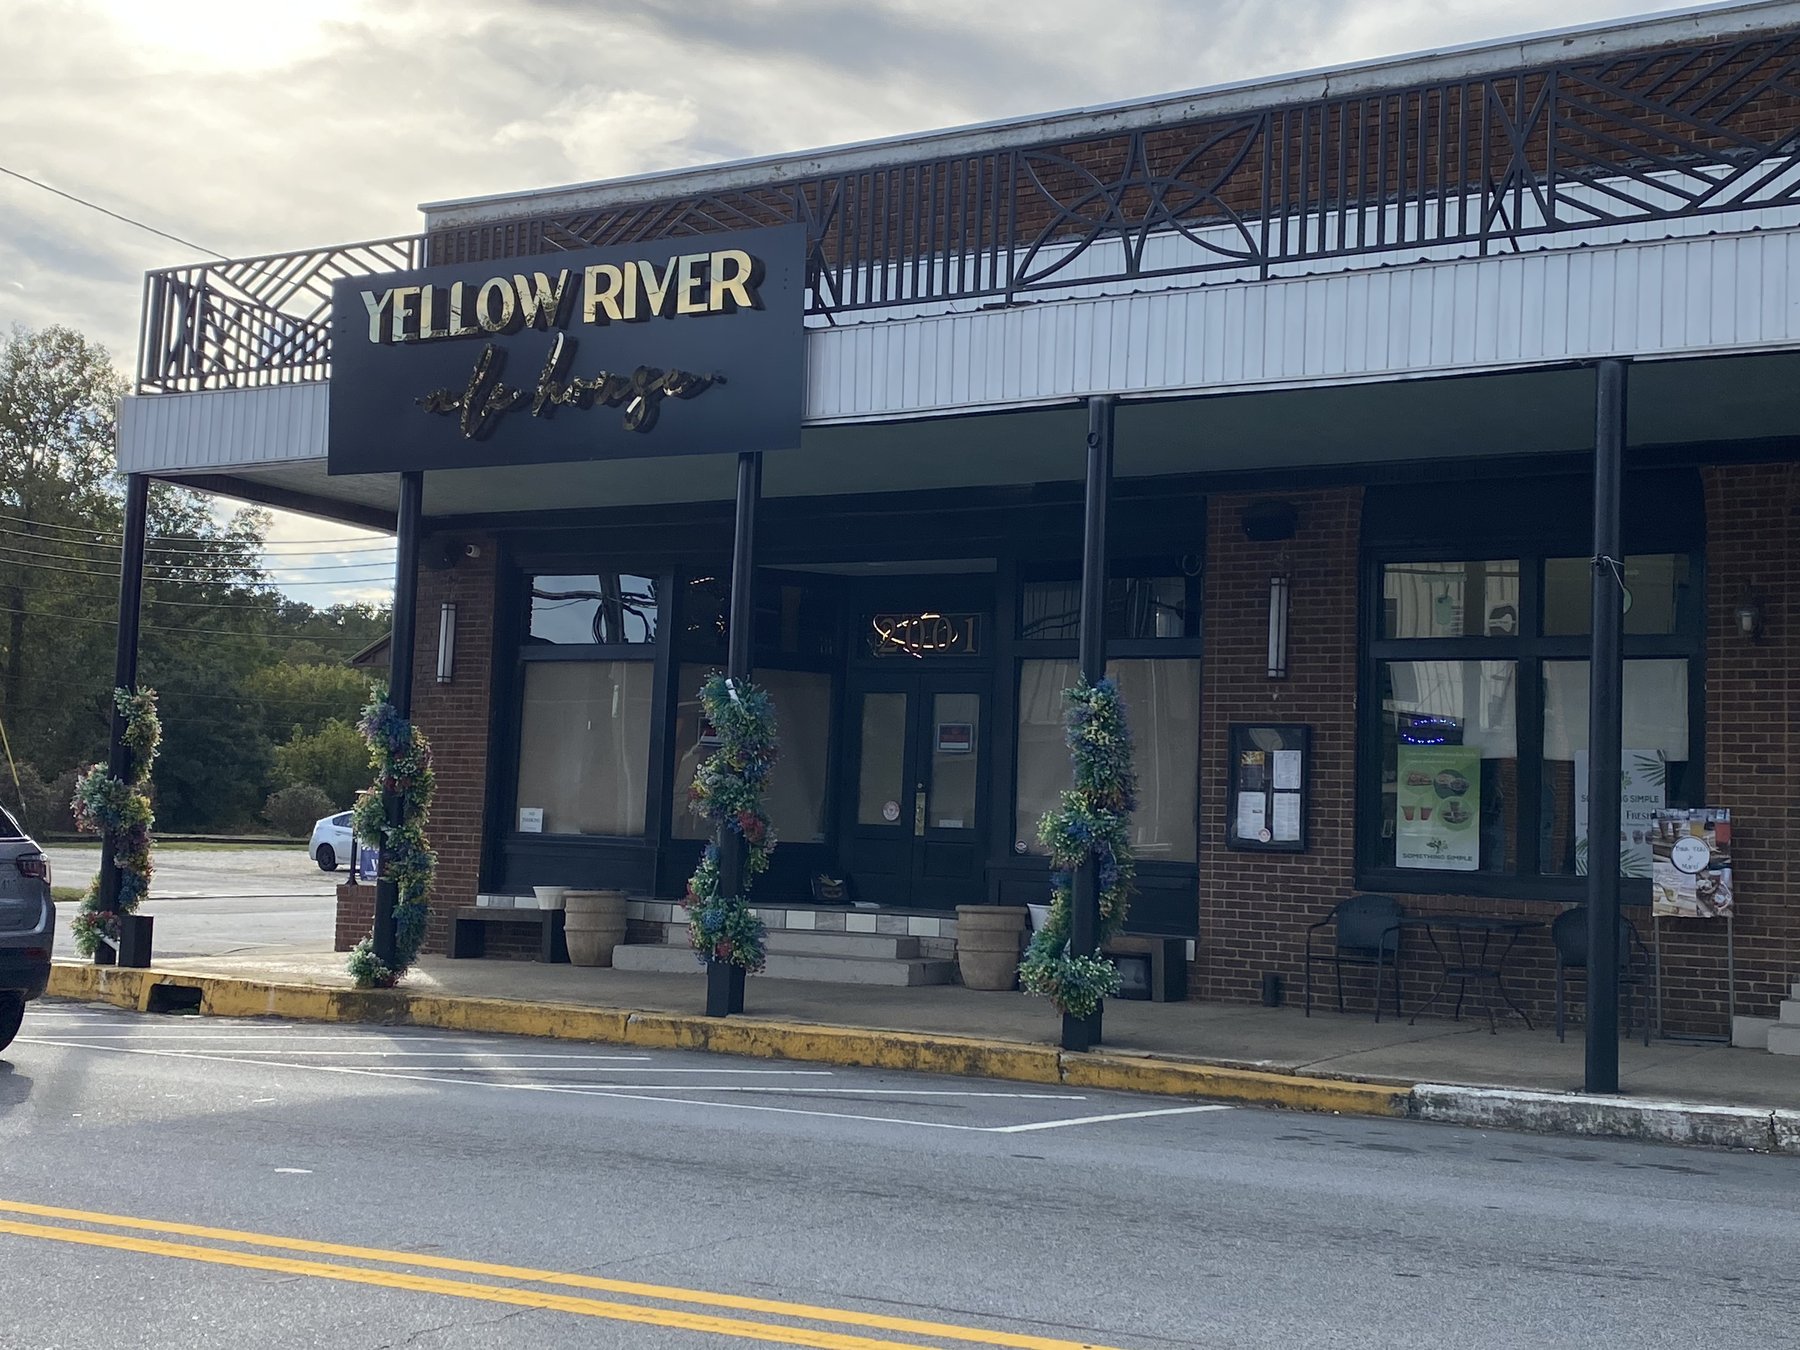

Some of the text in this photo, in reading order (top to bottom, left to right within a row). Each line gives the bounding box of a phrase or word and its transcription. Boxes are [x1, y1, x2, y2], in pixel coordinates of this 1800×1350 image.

[360, 249, 755, 345] YELLOW RIVER
[878, 616, 977, 653] 2001
[1630, 795, 1659, 804] SIMPLE
